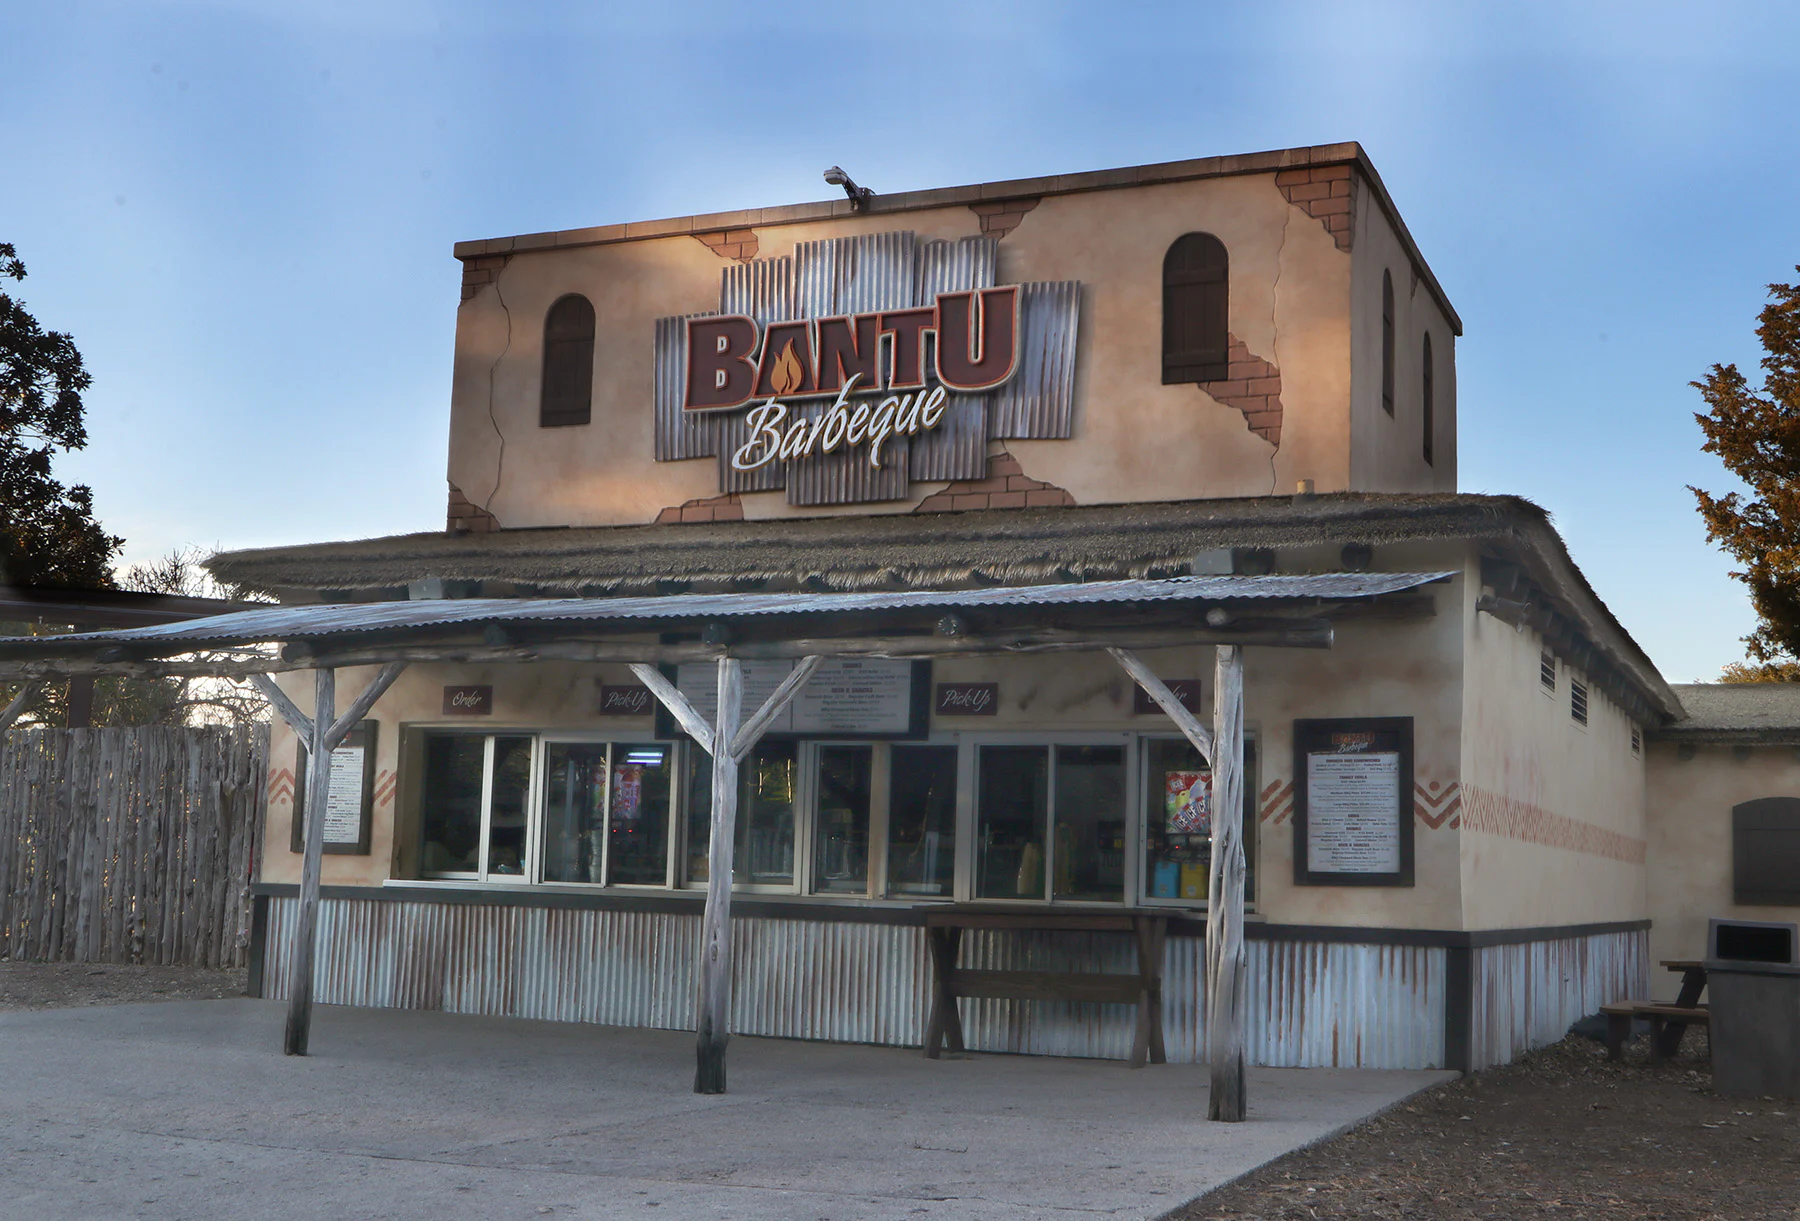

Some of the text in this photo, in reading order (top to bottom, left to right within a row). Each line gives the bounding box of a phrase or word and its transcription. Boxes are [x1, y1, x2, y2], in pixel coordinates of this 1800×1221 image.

[683, 285, 1022, 412] BANTU
[731, 372, 948, 471] Barbeque
[452, 690, 482, 707] Order
[941, 688, 991, 711] Pick-Up
